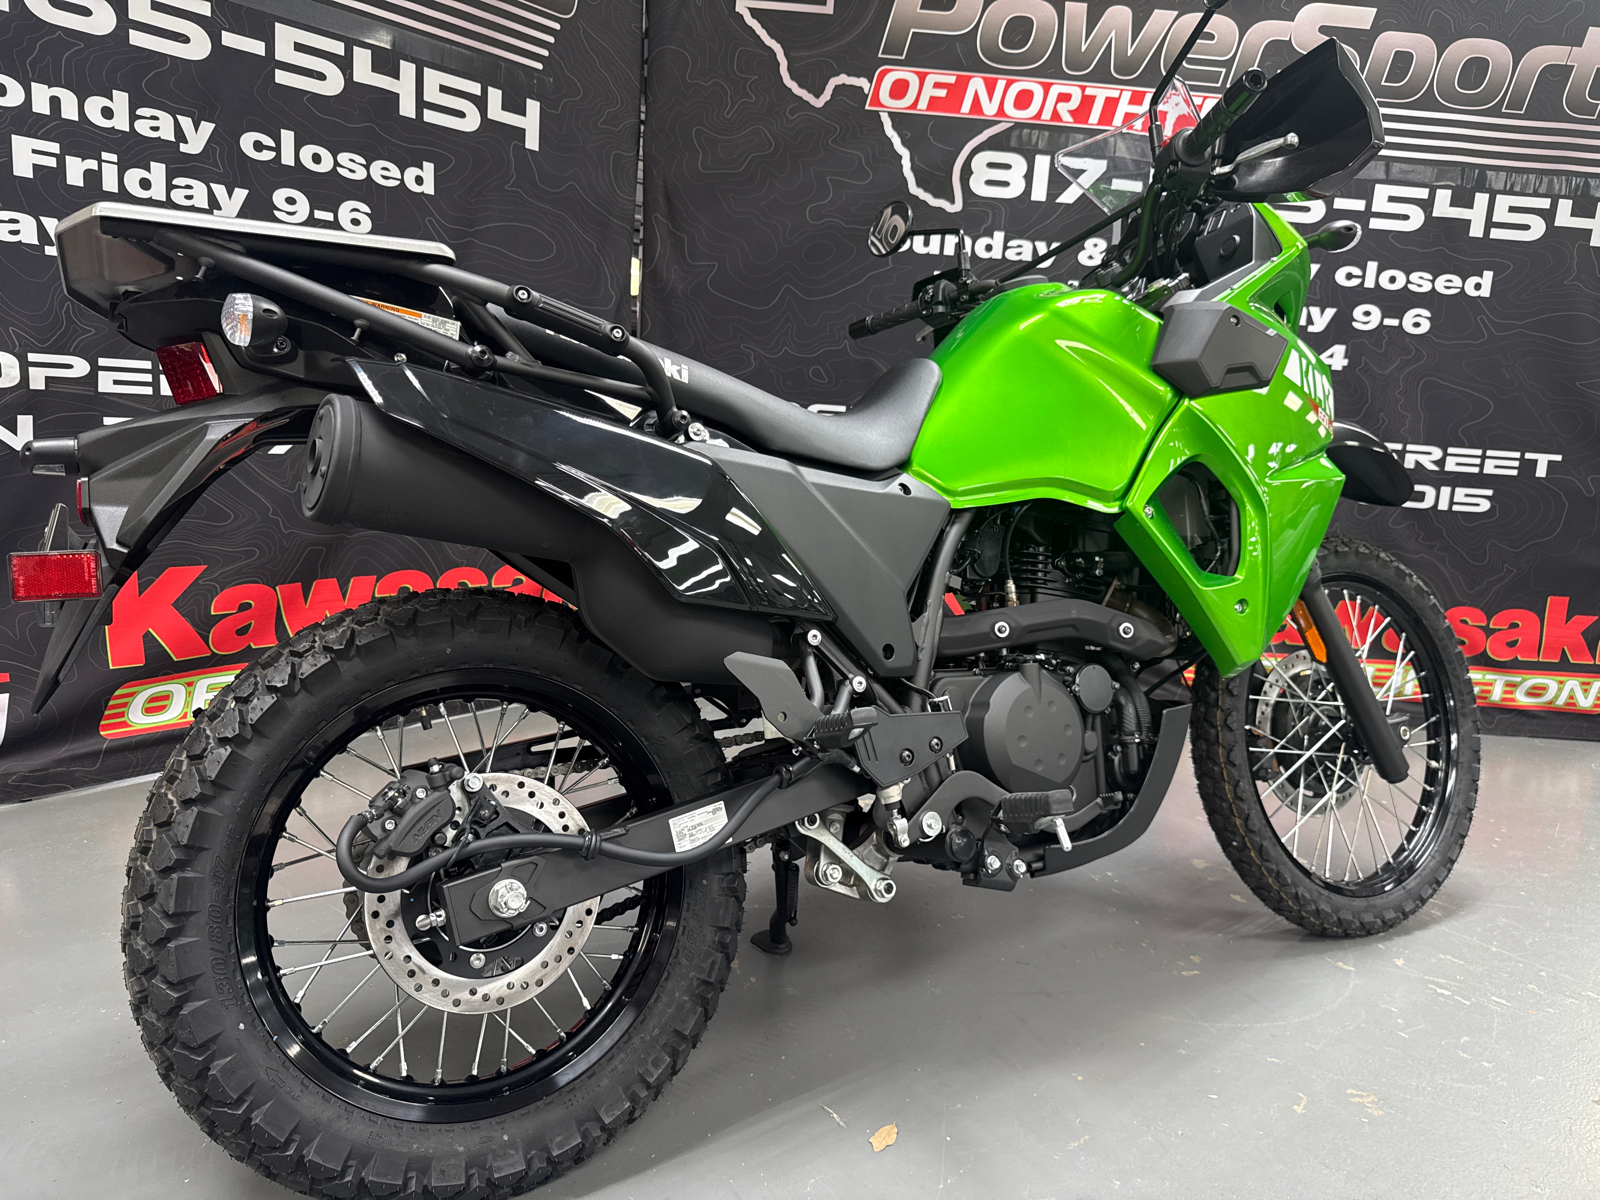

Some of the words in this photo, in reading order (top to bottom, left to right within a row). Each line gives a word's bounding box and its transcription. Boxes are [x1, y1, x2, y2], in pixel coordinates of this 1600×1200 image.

[878, 70, 950, 110] OF
[959, 76, 1150, 130] NORTH
[239, 128, 435, 195] closed
[11, 133, 249, 218] Friday
[272, 187, 372, 234] 9-6
[897, 230, 1062, 269] unday
[1334, 260, 1494, 298] closed
[1352, 303, 1432, 335] 9-6
[1384, 442, 1563, 478] REET
